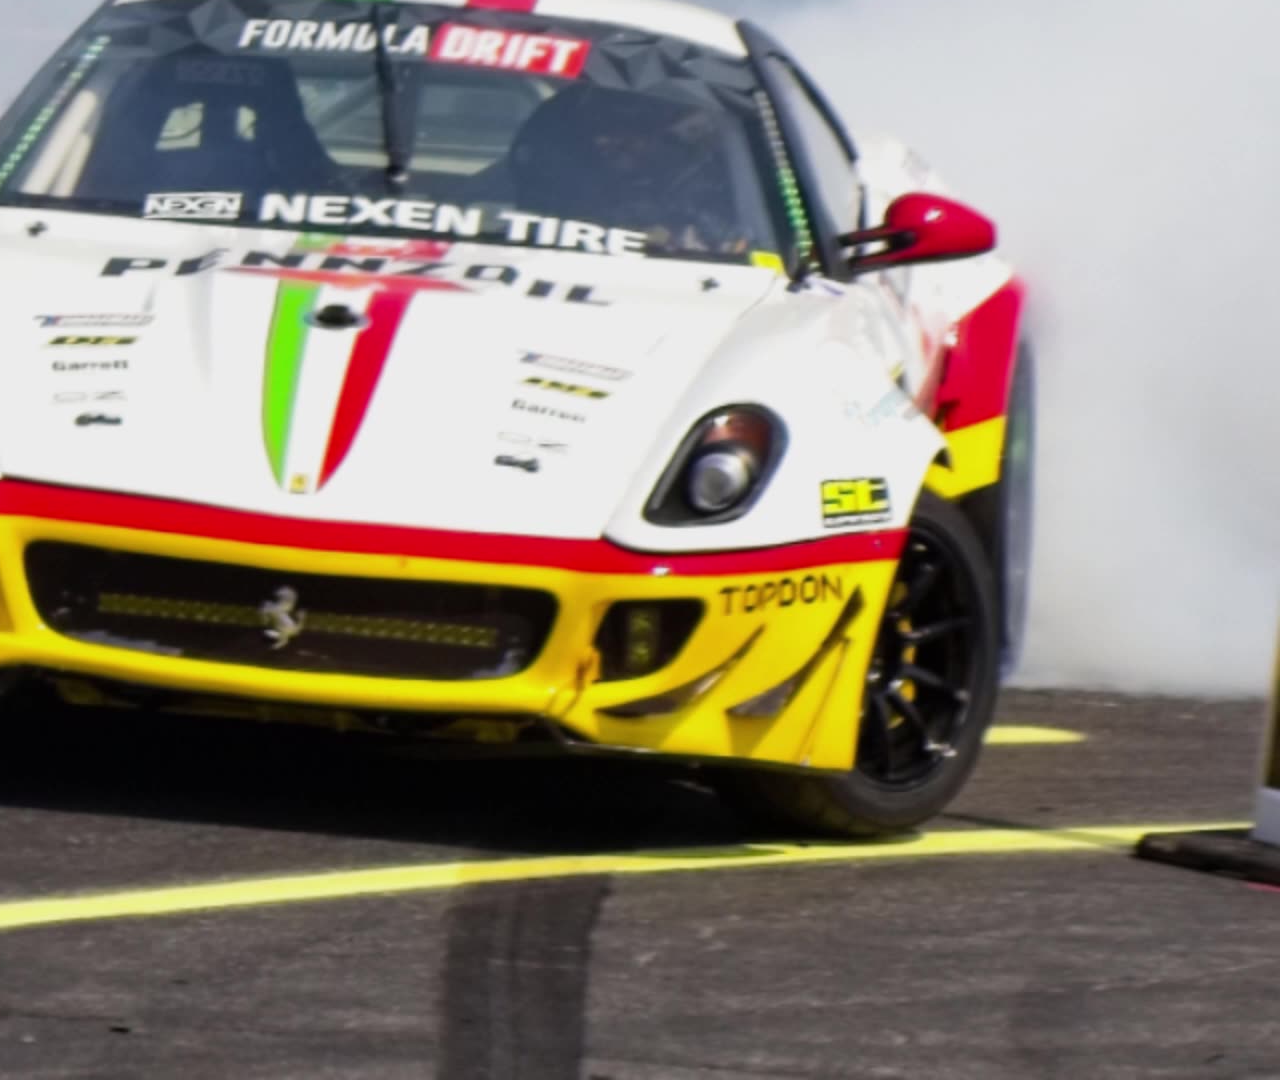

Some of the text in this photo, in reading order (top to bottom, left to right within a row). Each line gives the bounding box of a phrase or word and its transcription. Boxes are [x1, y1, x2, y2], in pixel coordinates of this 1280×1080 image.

[238, 19, 584, 75] FORMULA DRIFT
[258, 194, 484, 236] NEXEN
[498, 210, 648, 257] TIRE
[99, 247, 615, 307] PENNZOIL
[718, 574, 844, 616] TOPDON
